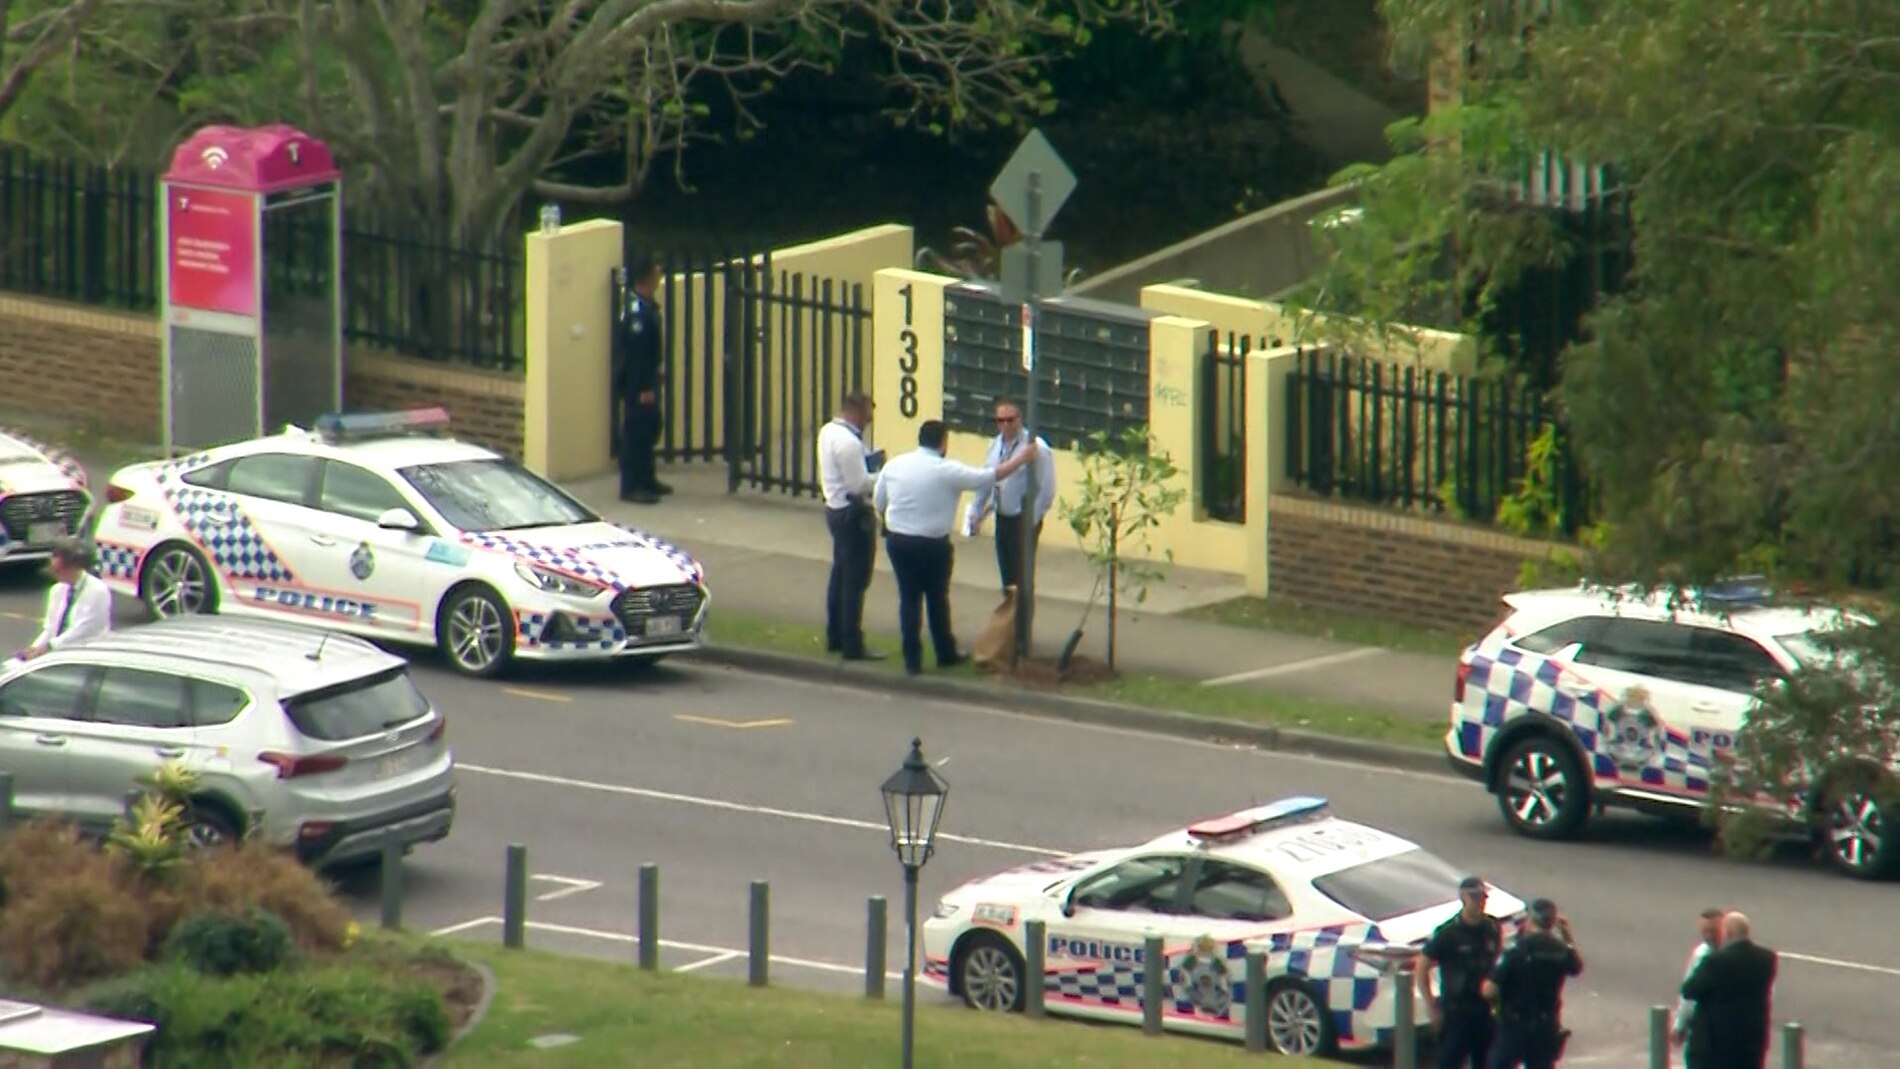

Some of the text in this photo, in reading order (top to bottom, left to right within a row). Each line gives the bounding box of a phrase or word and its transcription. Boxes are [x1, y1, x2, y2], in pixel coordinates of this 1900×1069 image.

[898, 283, 919, 419] 138
[254, 586, 379, 621] POLICE
[1049, 935, 1146, 963] POLICE
